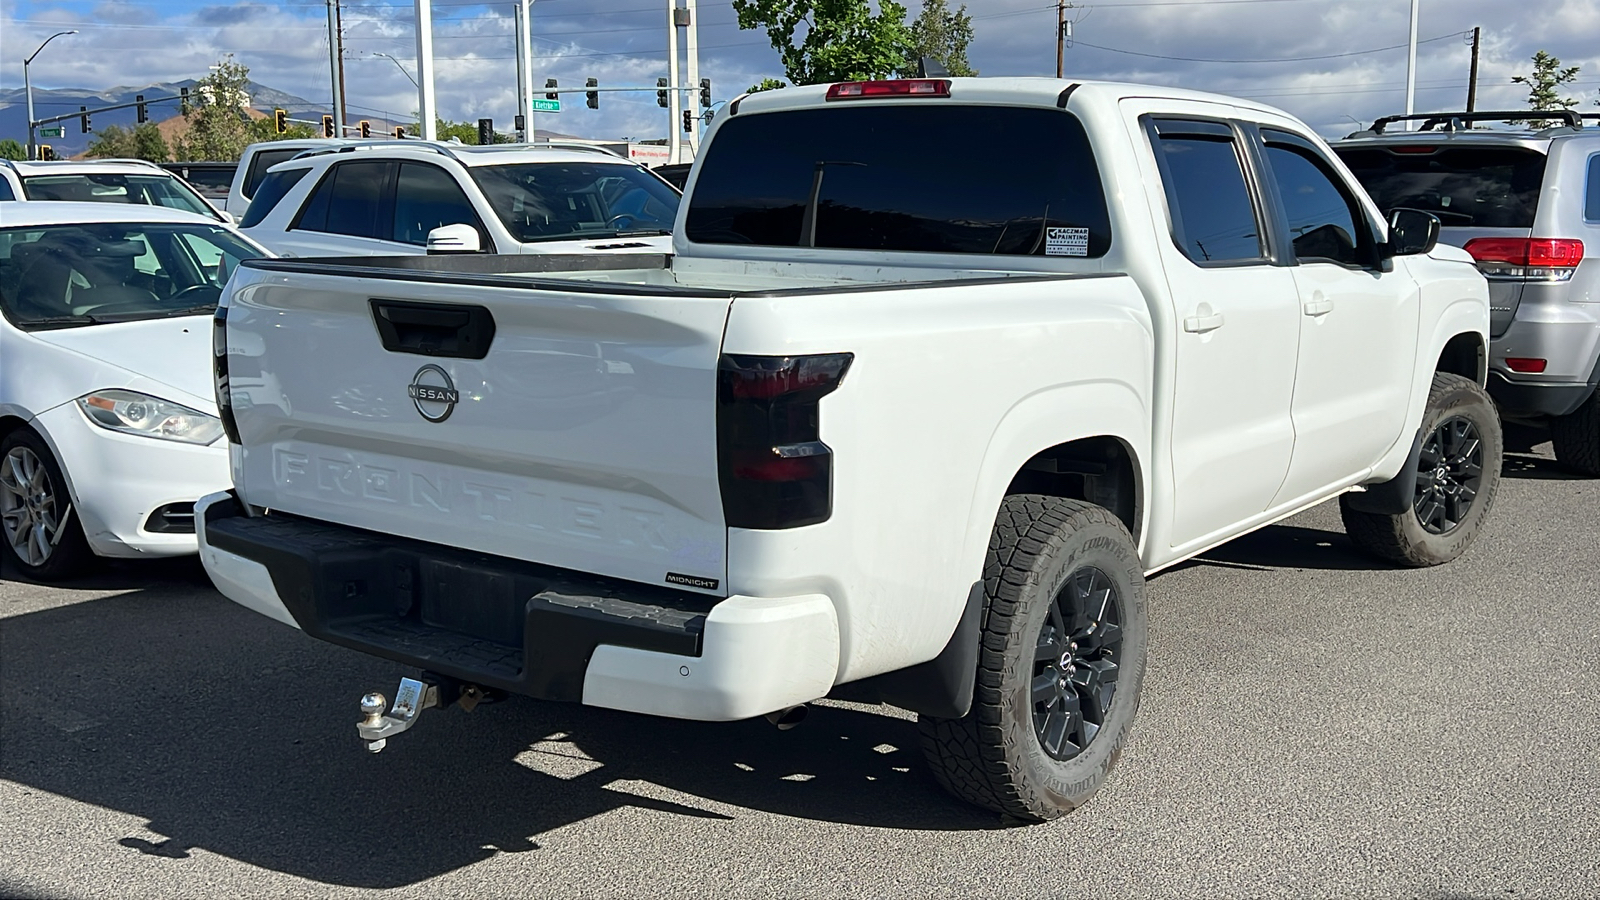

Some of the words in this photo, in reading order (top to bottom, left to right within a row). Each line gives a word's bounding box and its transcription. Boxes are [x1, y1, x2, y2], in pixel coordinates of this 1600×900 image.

[408, 387, 456, 401] NISSAN
[277, 451, 670, 552] FRONTIER
[1081, 536, 1129, 563] COUNTRY
[667, 575, 715, 588] MIDNIGHT
[1043, 774, 1097, 797] COUNTRY
